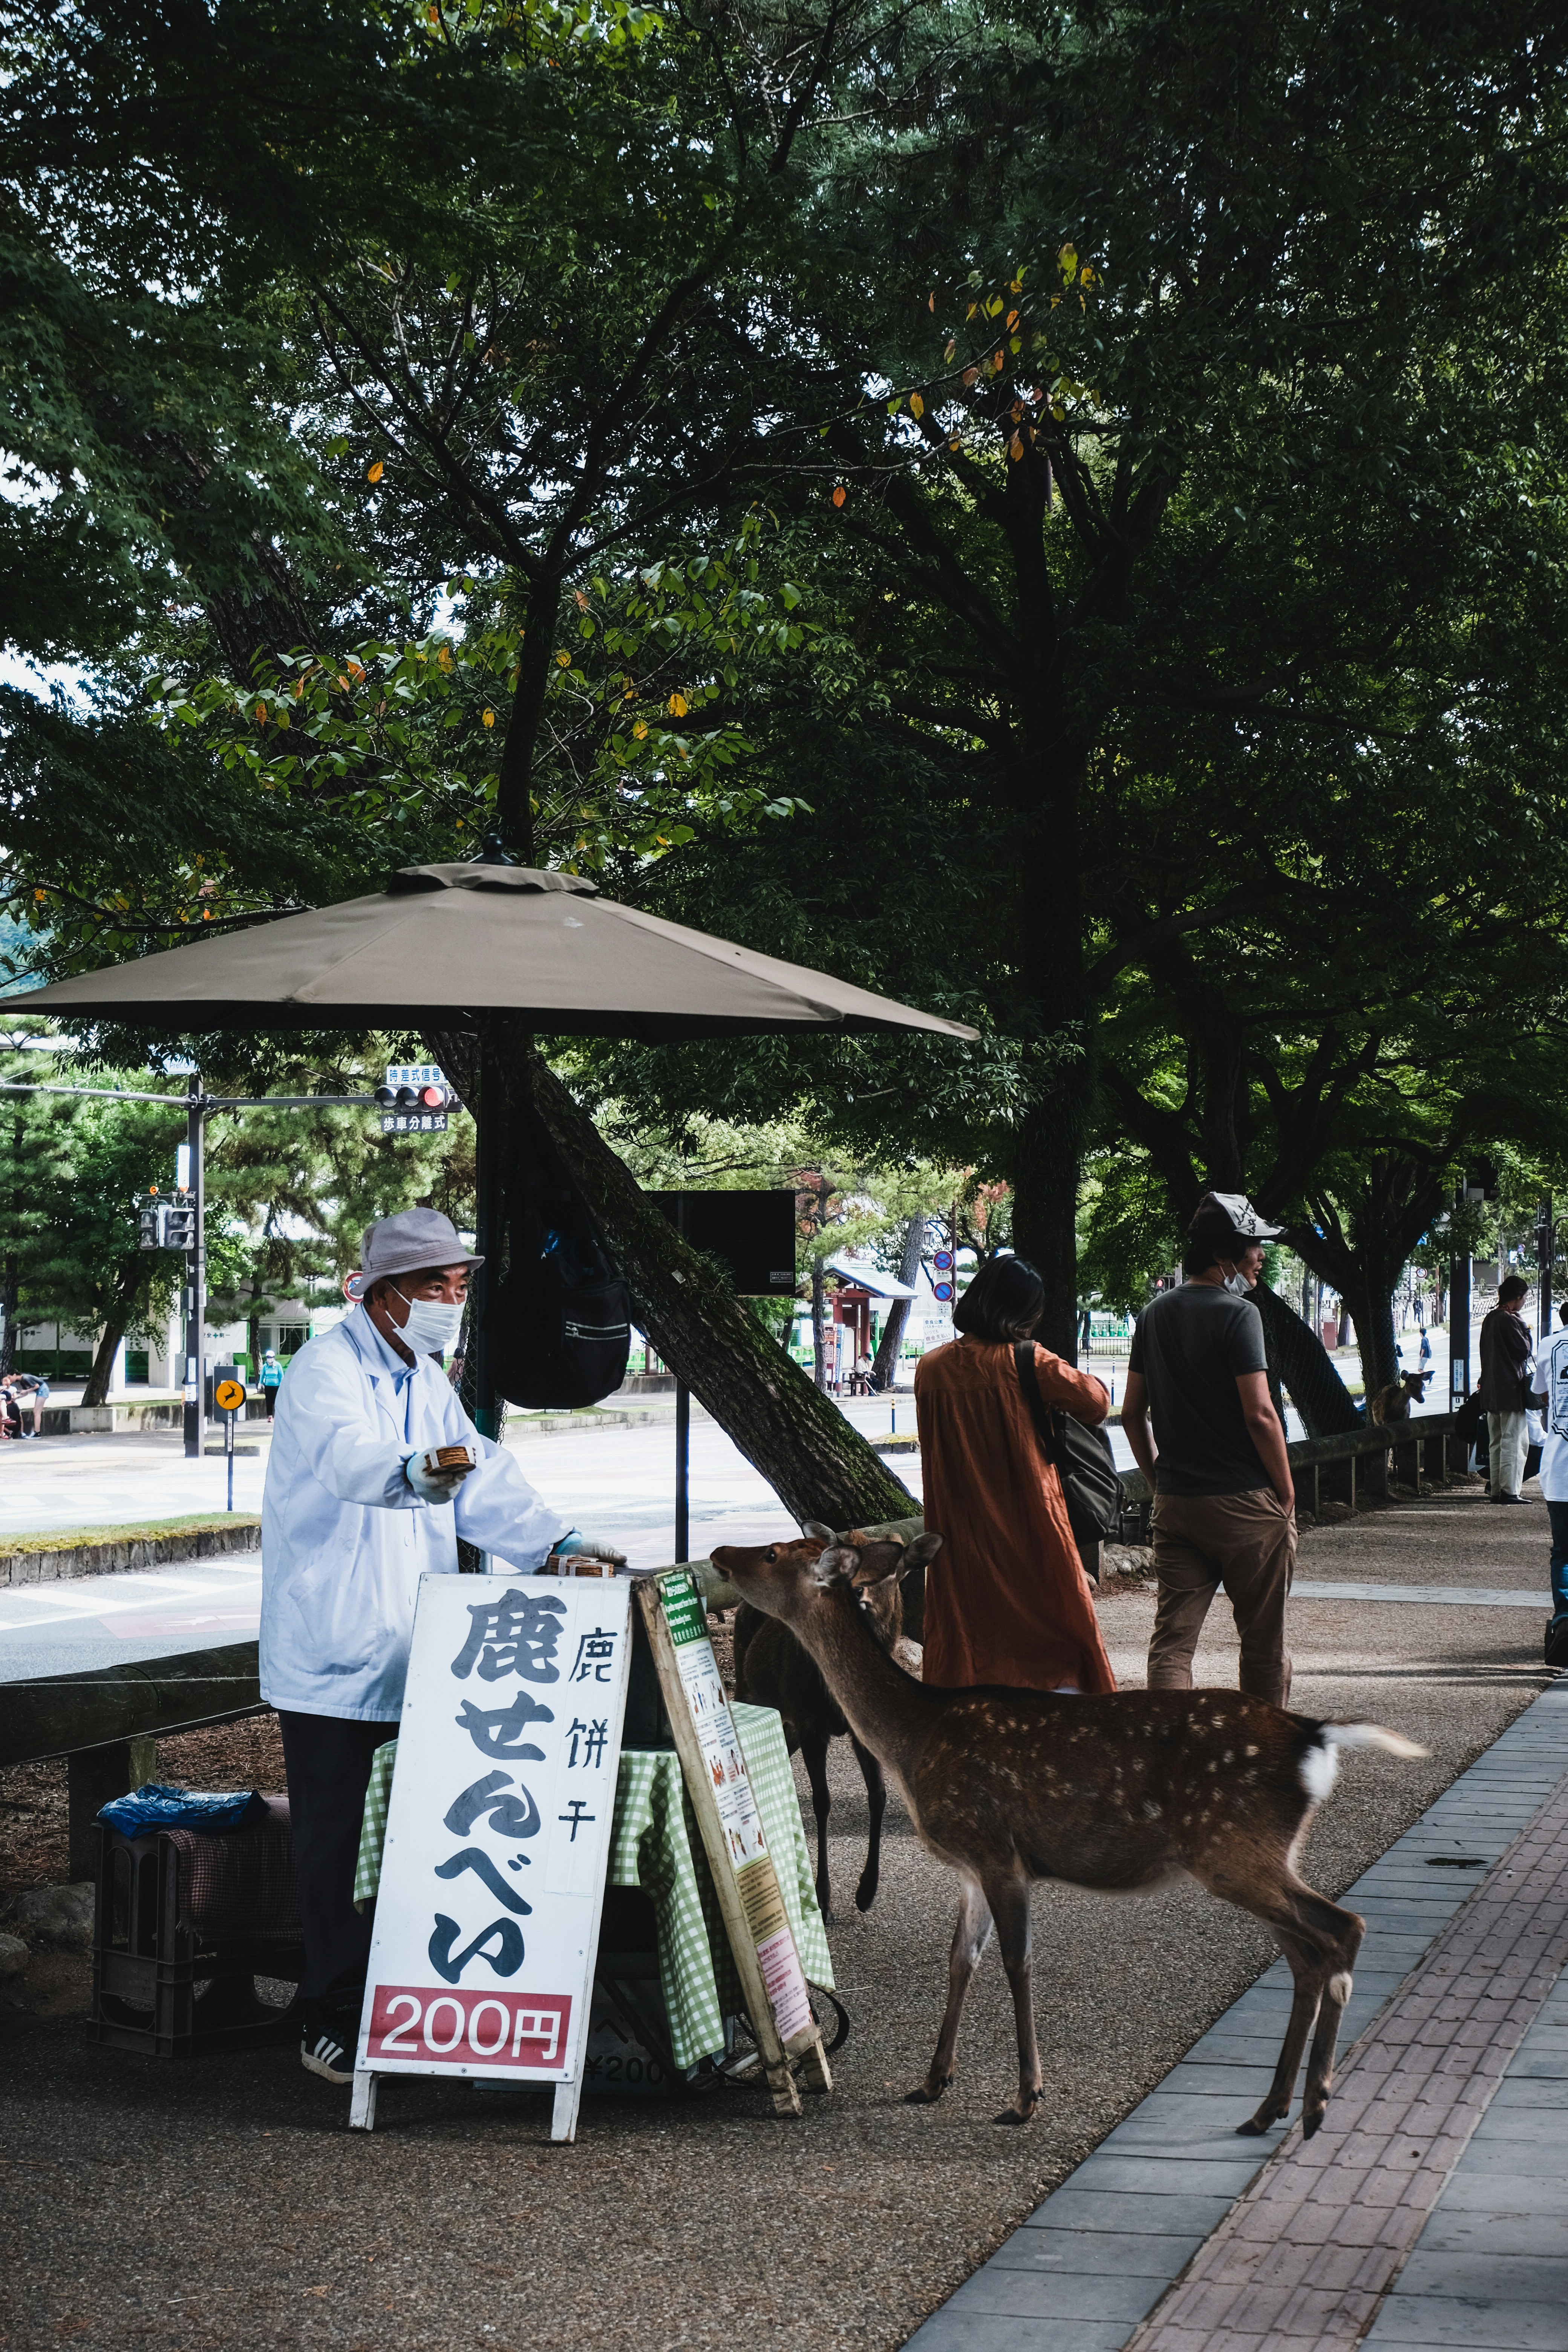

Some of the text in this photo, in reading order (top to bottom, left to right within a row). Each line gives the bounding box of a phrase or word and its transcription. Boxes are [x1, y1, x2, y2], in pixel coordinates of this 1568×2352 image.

[384, 1115, 445, 1131] 歩車分離式
[558, 1627, 618, 1842] 鹿饼干
[428, 1588, 567, 1984] 鹿せんべい
[380, 1992, 564, 2061] 200円
[585, 2055, 664, 2085] ¥200
